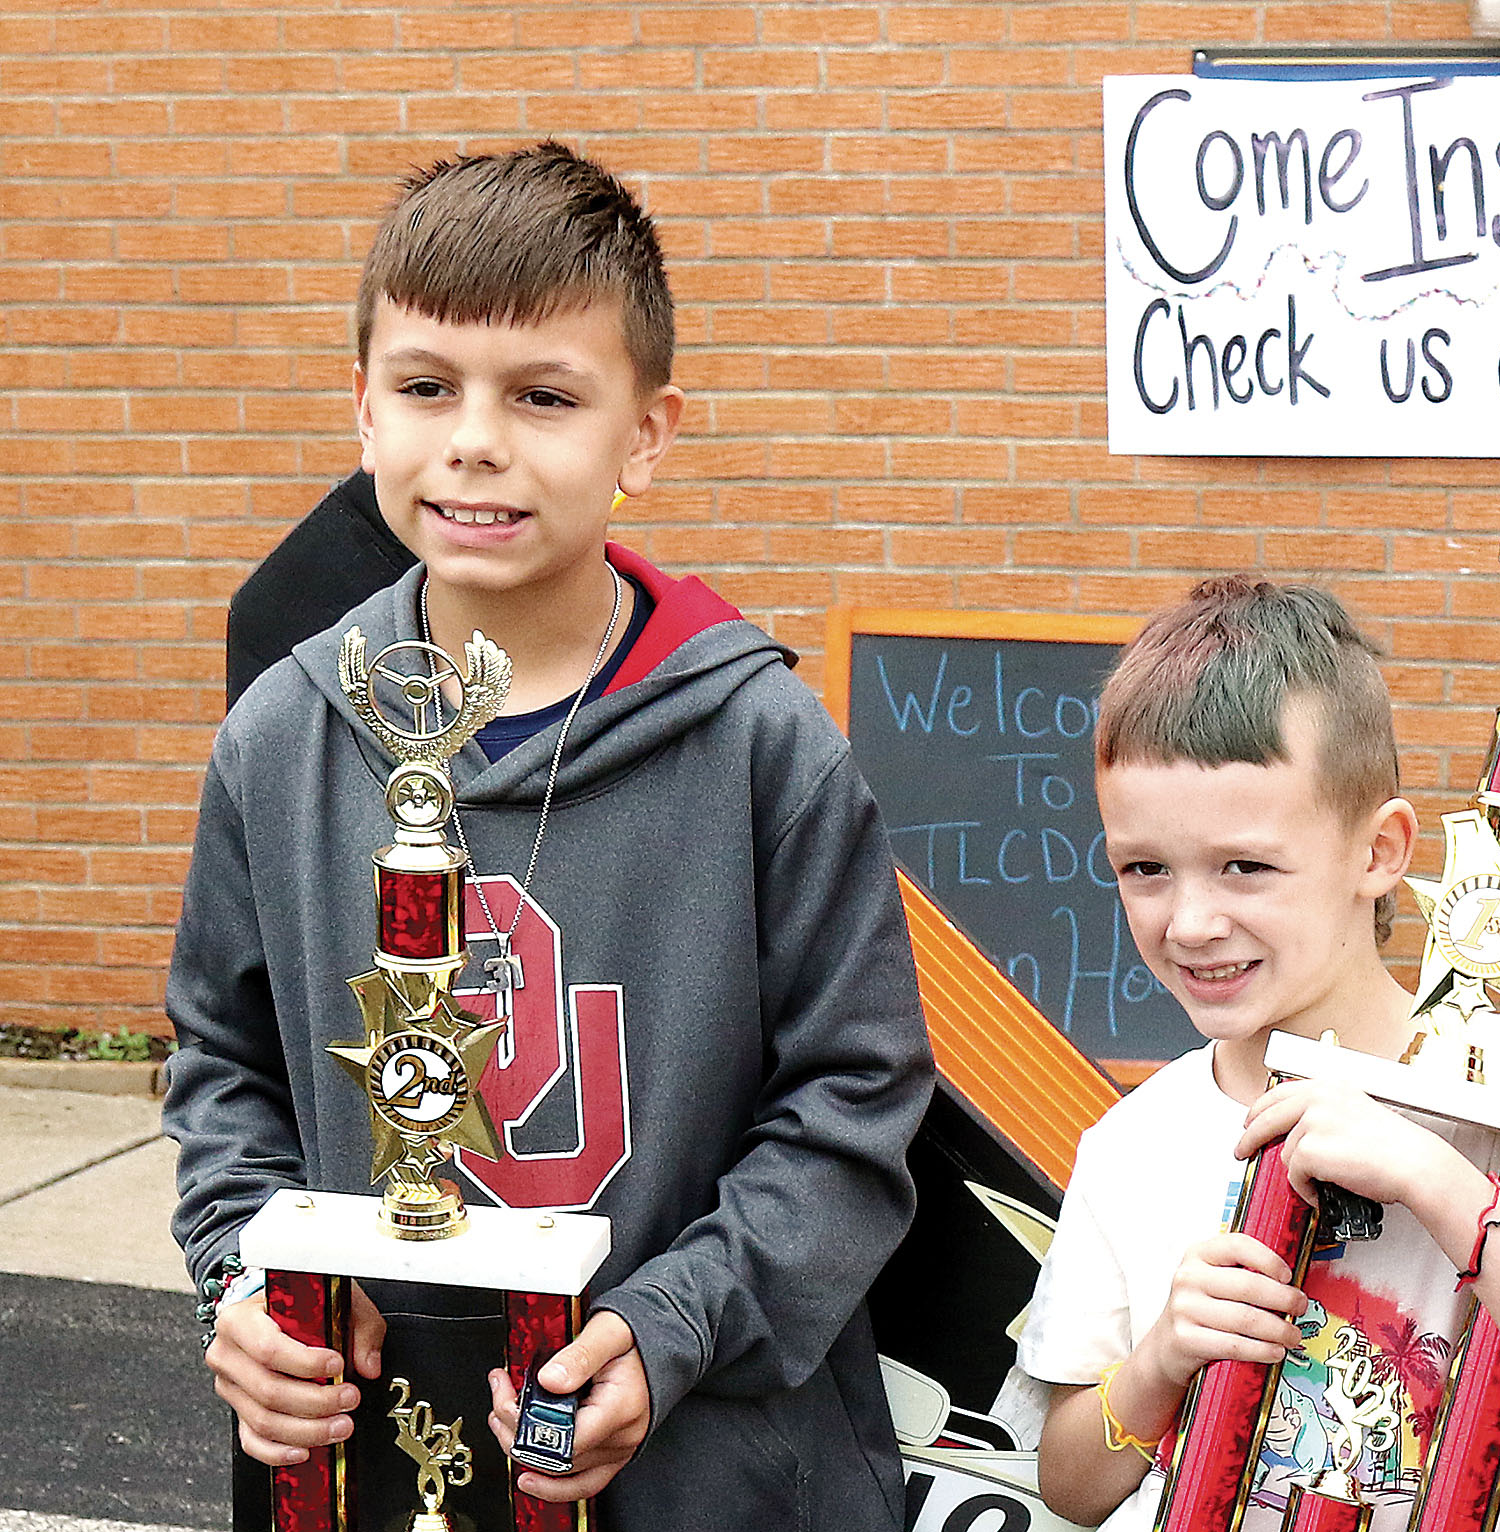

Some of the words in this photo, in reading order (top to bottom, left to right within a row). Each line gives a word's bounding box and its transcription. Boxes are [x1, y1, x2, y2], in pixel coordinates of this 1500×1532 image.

[1125, 89, 1368, 284] Come
[1133, 294, 1331, 414] Check
[1381, 328, 1453, 404] us
[877, 651, 1100, 737] Welco
[990, 752, 1076, 811] To
[382, 1053, 458, 1109] 2nd
[386, 1377, 473, 1487] 2023
[1323, 1325, 1401, 1452] 2023
